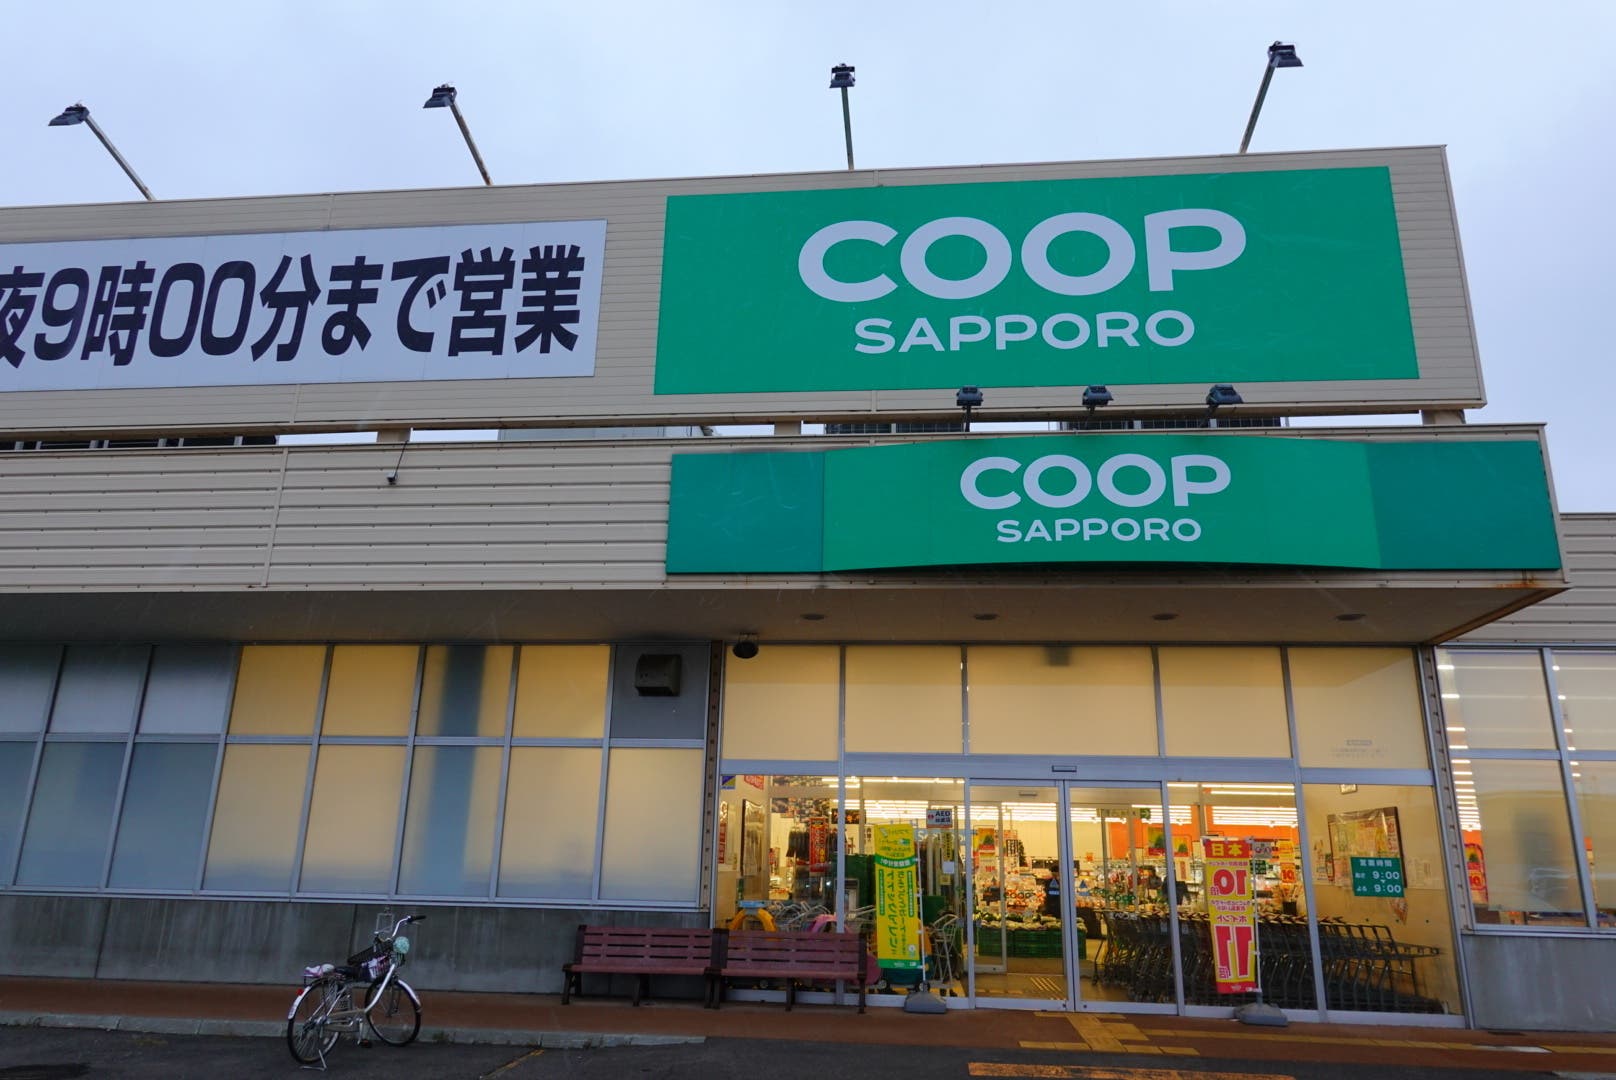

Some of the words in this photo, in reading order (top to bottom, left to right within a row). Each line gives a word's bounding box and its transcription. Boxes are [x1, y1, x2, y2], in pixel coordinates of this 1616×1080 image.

[799, 209, 1247, 303] COOP
[855, 311, 1195, 354] SAPPORO
[960, 453, 1232, 511] COOP
[996, 518, 1202, 543] SAPPORO
[1372, 871, 1400, 879] 9:00
[1374, 884, 1401, 893] 9:00
